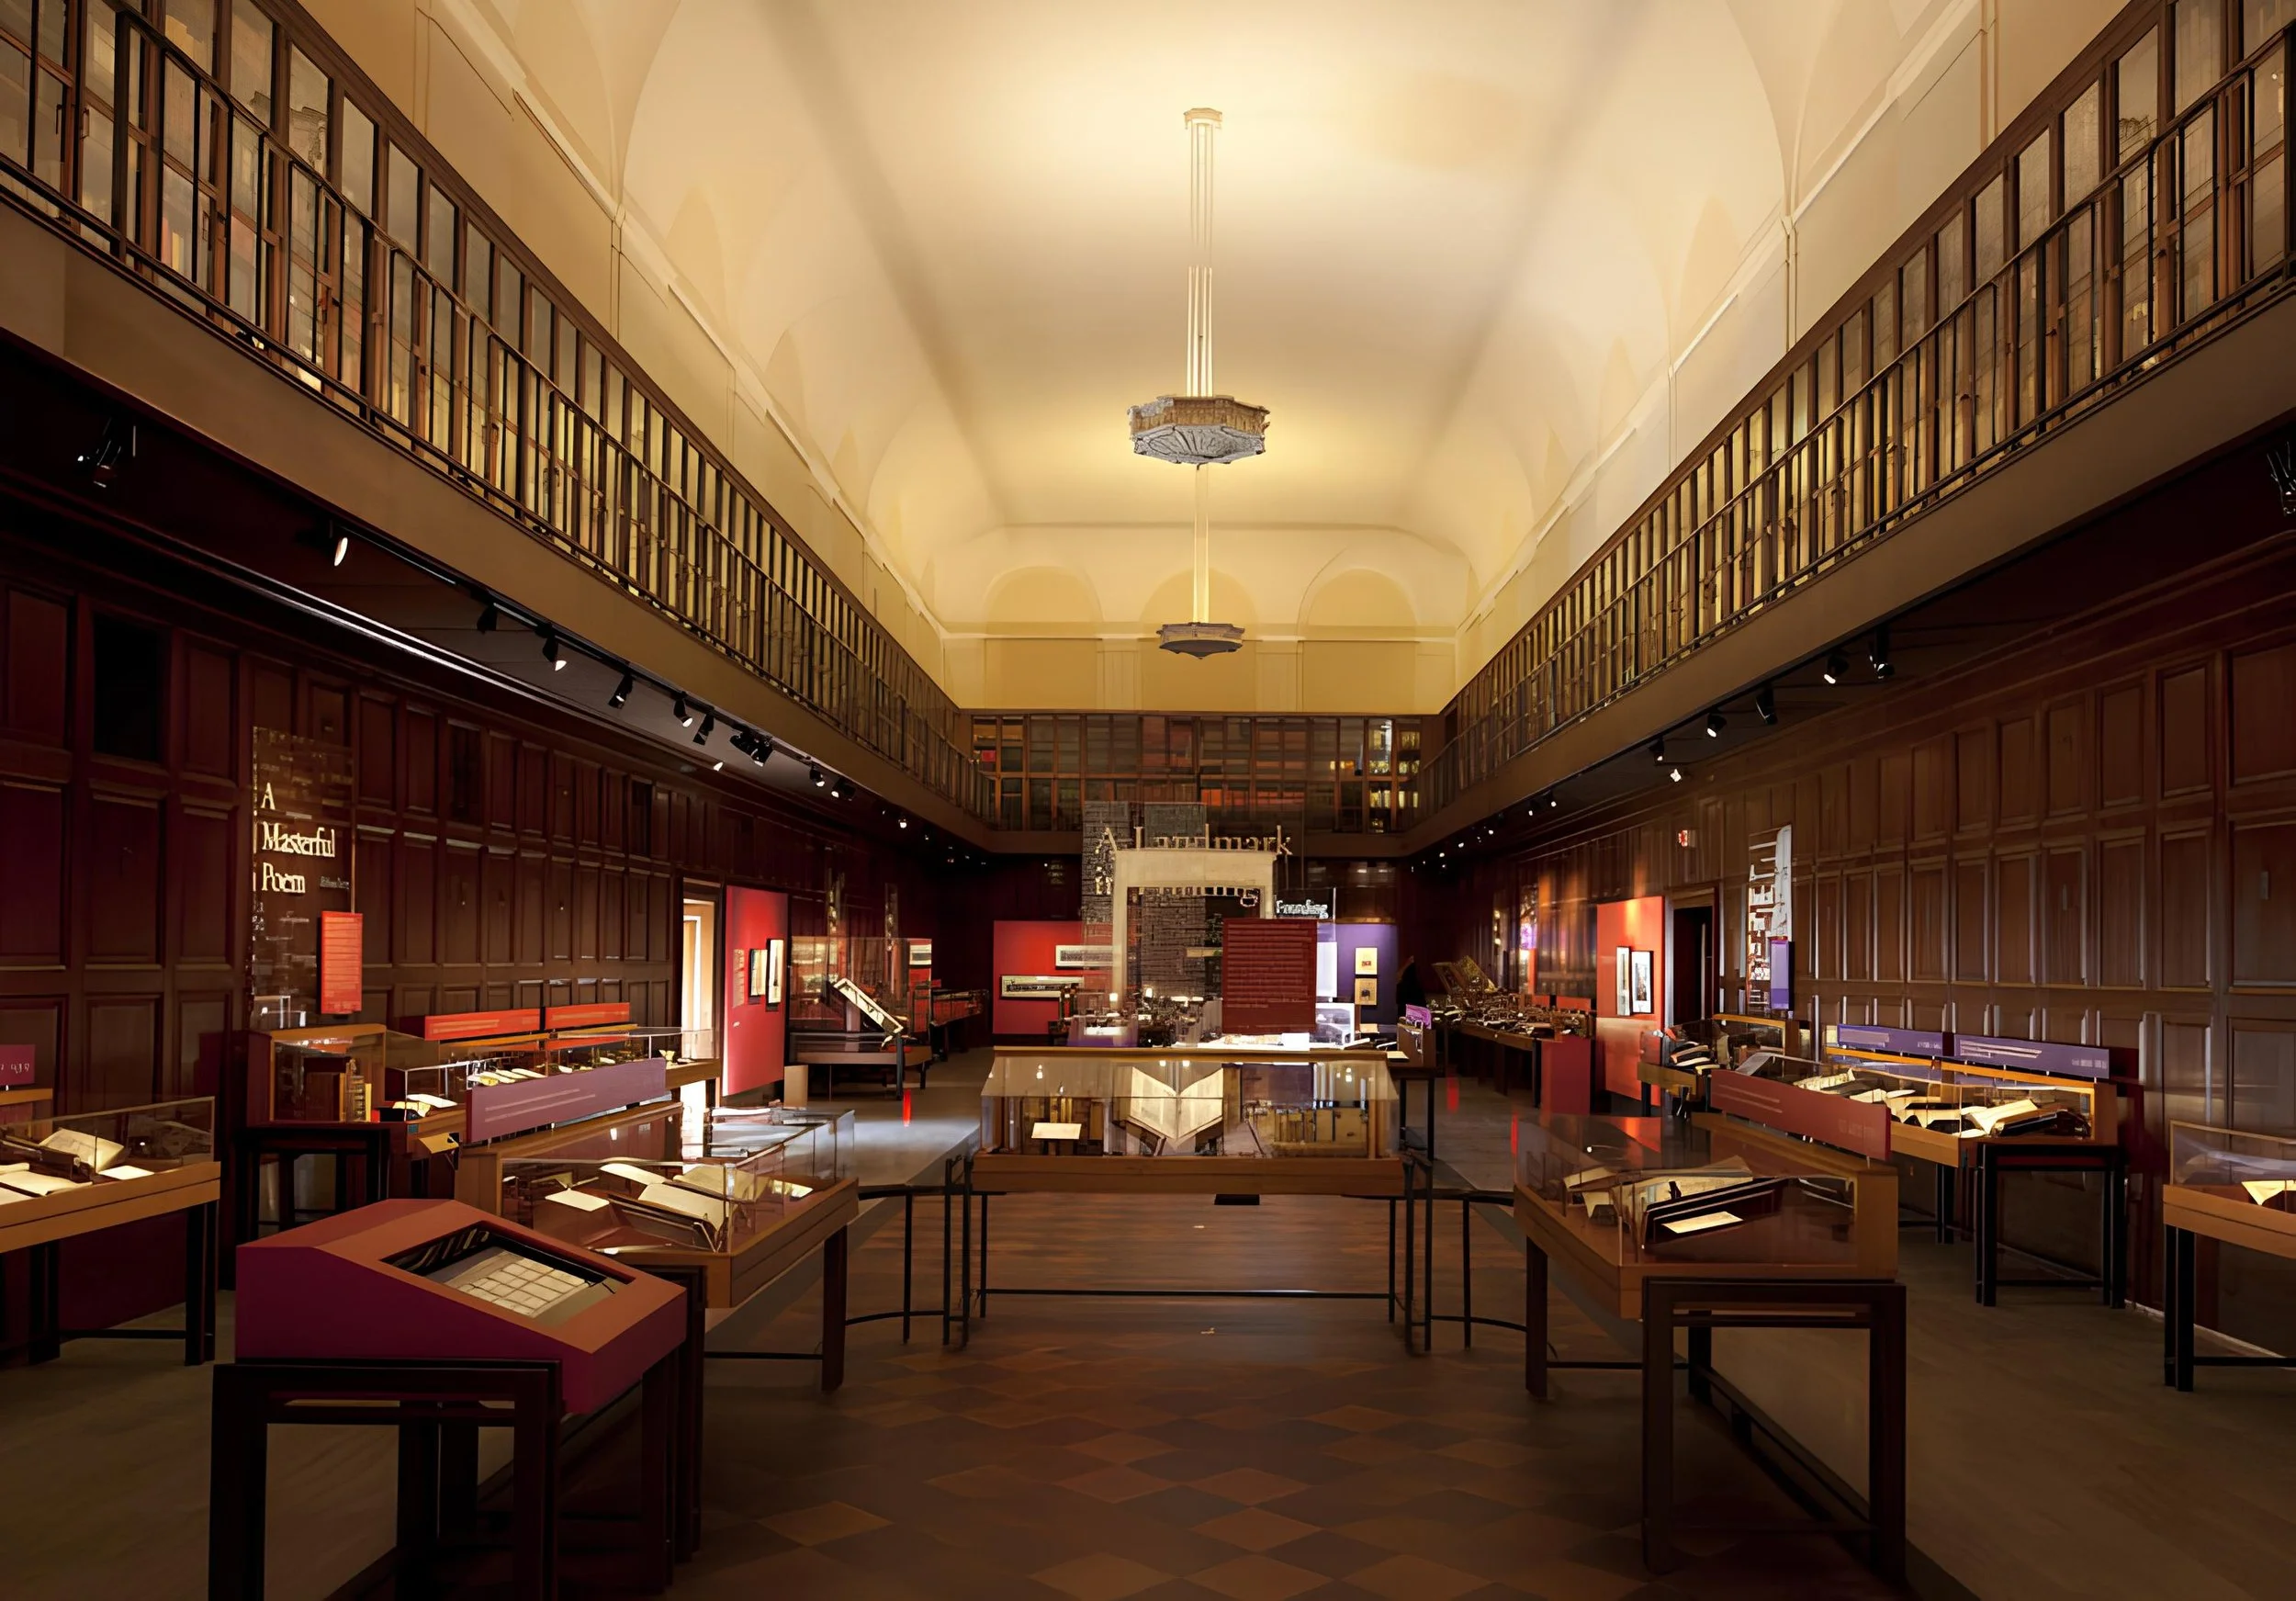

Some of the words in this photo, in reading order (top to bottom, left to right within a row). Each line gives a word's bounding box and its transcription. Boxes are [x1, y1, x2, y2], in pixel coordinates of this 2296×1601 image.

[260, 782, 276, 810] A
[262, 820, 336, 858] Masterful
[261, 862, 306, 894] Poem
